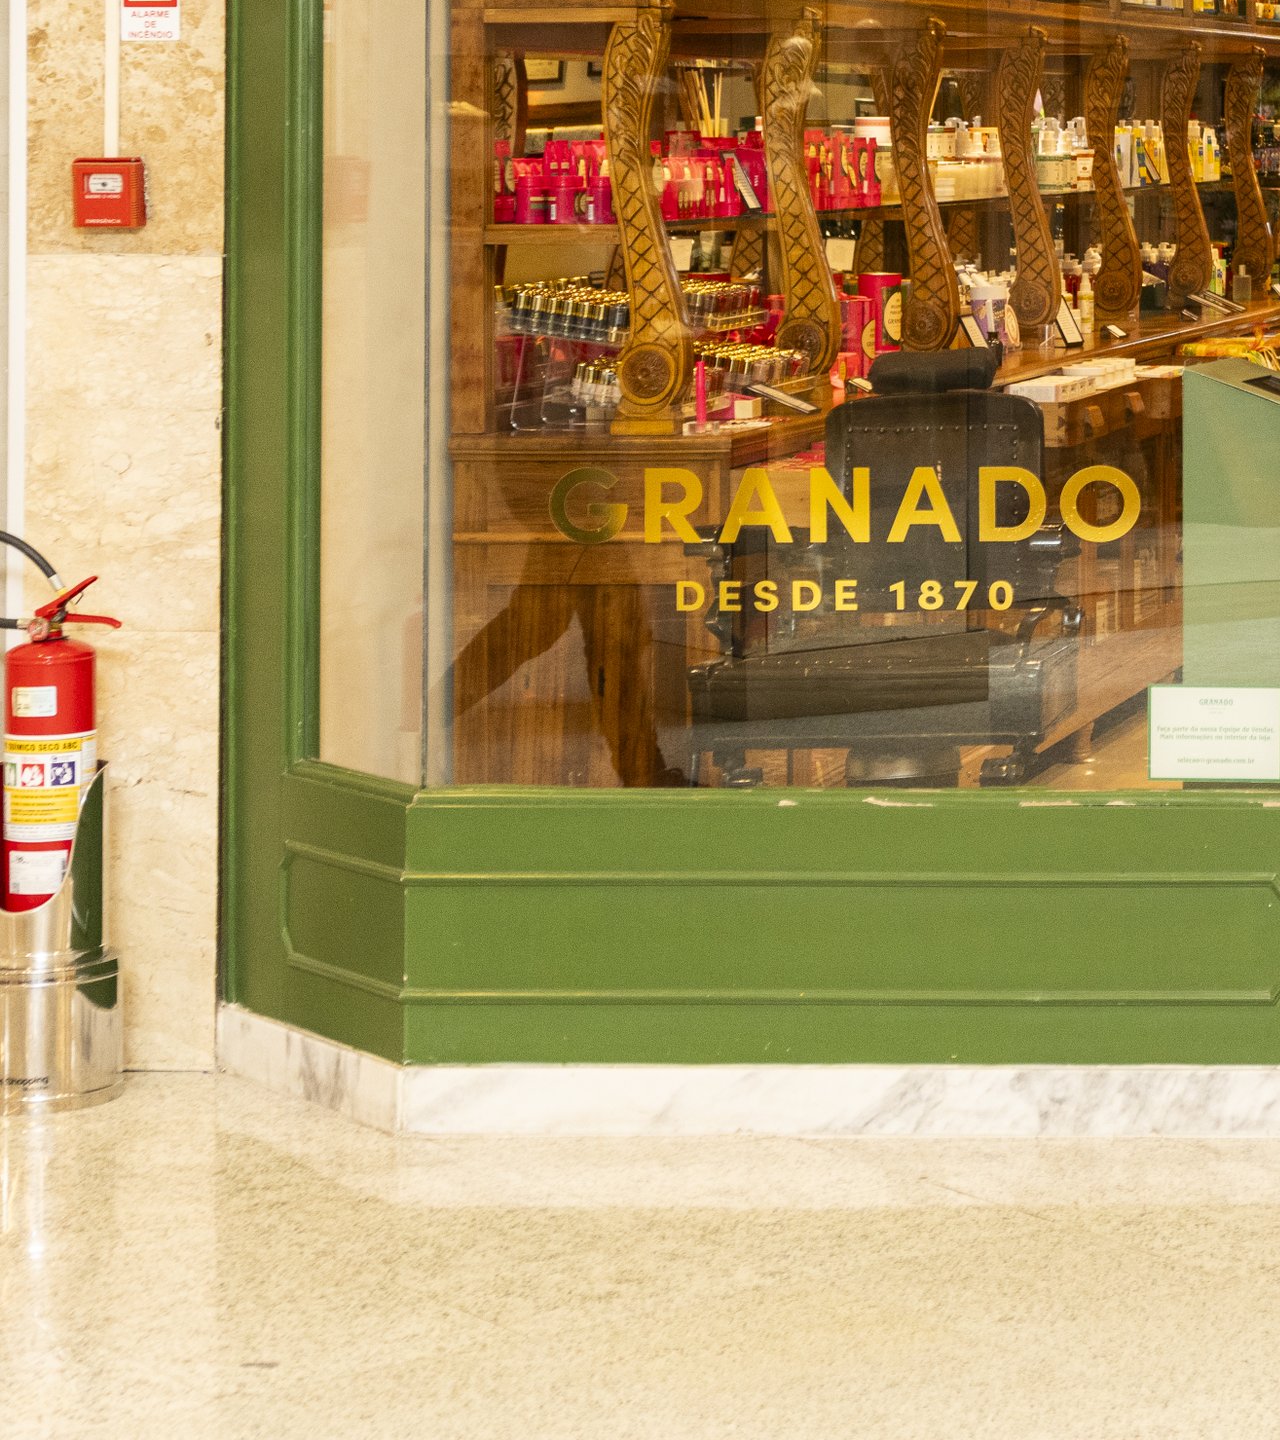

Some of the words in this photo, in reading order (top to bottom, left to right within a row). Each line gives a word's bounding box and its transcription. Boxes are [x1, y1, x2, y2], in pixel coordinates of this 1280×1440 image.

[130, 10, 170, 18] ALARME
[144, 20, 157, 28] DE
[128, 30, 174, 39] INCÊNDIO
[547, 465, 1142, 545] GRANADO
[675, 580, 859, 612] DESDE
[888, 580, 1016, 612] 1870
[1198, 698, 1234, 706] GRANADO
